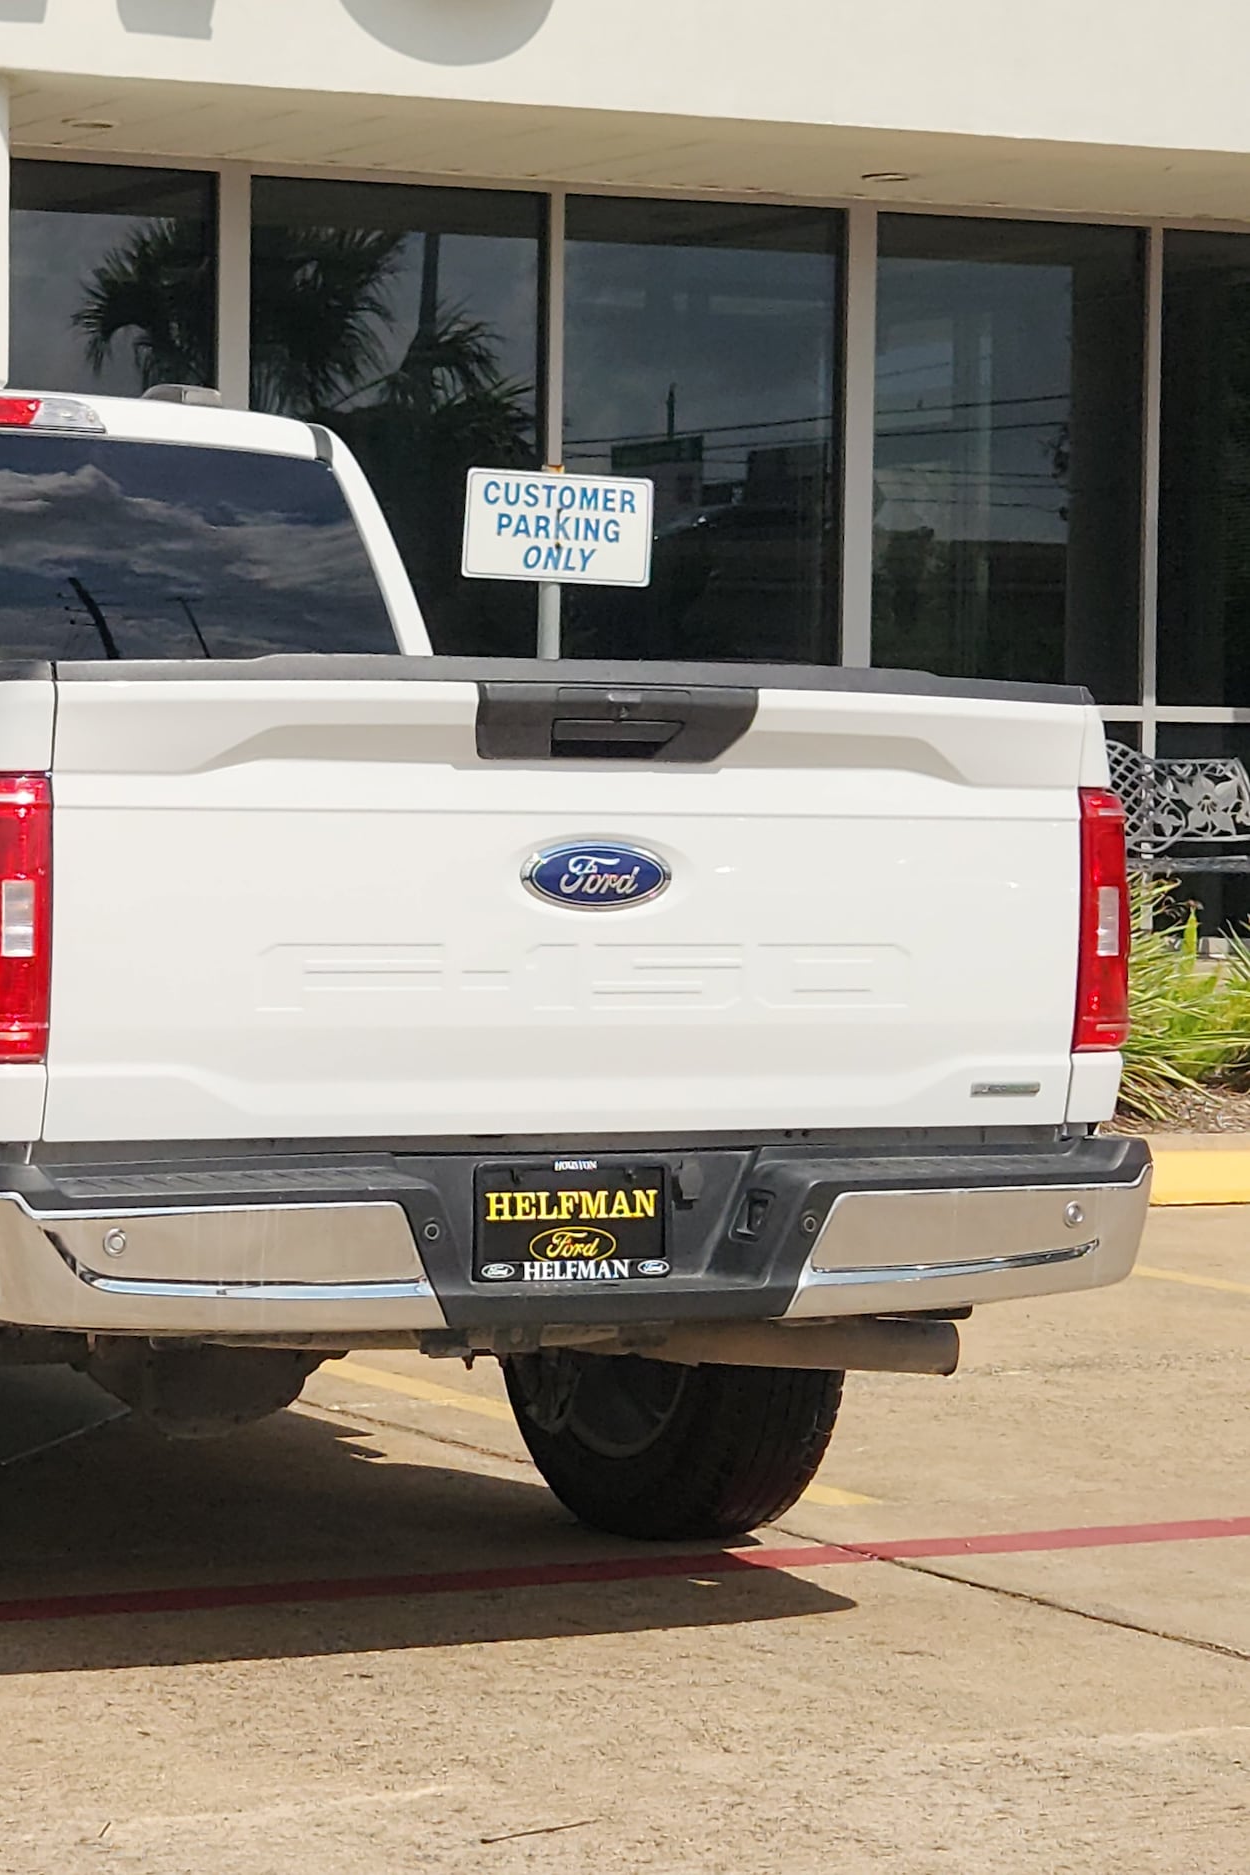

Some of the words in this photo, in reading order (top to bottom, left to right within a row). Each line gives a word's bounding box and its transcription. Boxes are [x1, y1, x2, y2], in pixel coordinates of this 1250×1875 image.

[483, 480, 636, 514] CUSTOMER
[497, 513, 621, 543] PARKING
[523, 545, 597, 573] ONLY
[560, 855, 640, 895] Ford
[485, 1189, 659, 1221] HELFMAN
[546, 1231, 600, 1258] Ford
[522, 1260, 630, 1281] HELFMAN
